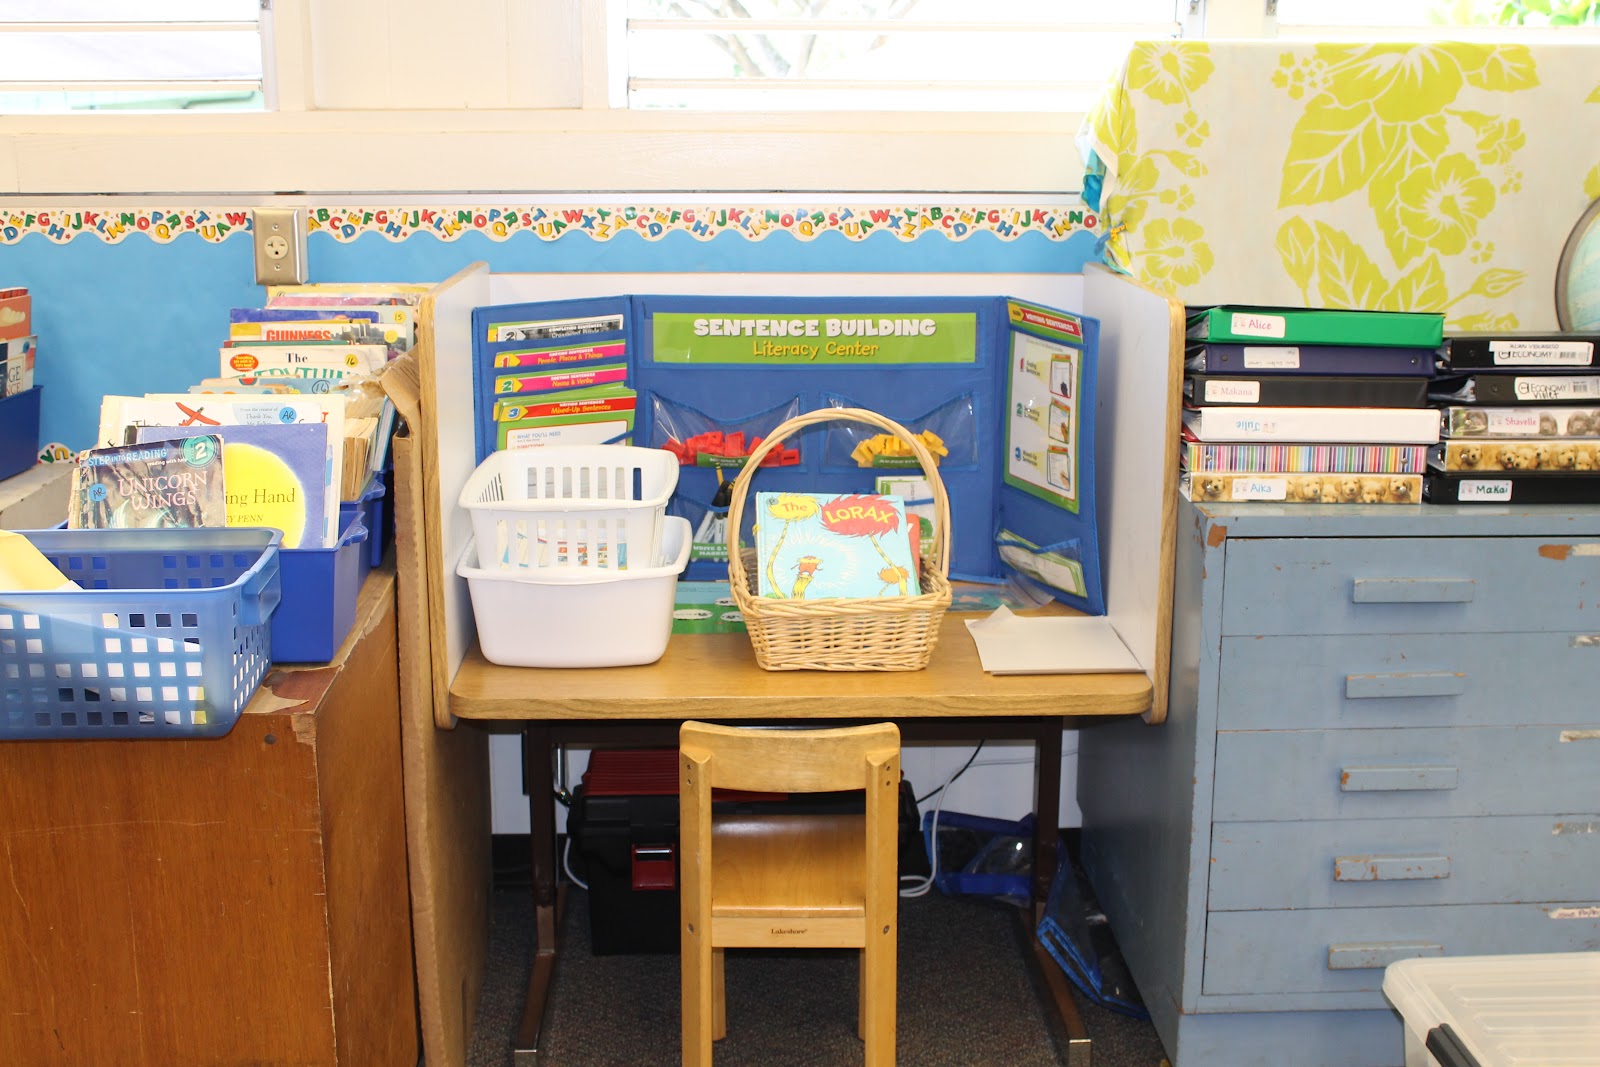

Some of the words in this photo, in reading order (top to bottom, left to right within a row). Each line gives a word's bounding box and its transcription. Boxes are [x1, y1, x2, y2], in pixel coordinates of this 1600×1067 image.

[693, 318, 820, 337] SENTENCE
[826, 318, 936, 337] BUILDING
[1248, 319, 1272, 330] Alice
[753, 340, 820, 360] Literacy
[826, 341, 880, 357] Center
[286, 352, 308, 362] The
[346, 356, 355, 365] 16
[503, 380, 512, 391] 2
[1530, 383, 1567, 393] ECONOMY
[1220, 387, 1253, 396] Makana
[508, 408, 519, 418] 3
[1236, 421, 1260, 432] Julie
[1505, 418, 1536, 426] Shavelle
[194, 441, 206, 460] 2
[88, 455, 110, 466] STEP
[126, 448, 167, 462] READING
[118, 470, 208, 497] UNICORN
[1250, 483, 1272, 492] Aika
[132, 490, 196, 511] WINGS
[254, 488, 295, 504] Hand
[781, 502, 808, 512] The
[825, 506, 894, 524] LORAX
